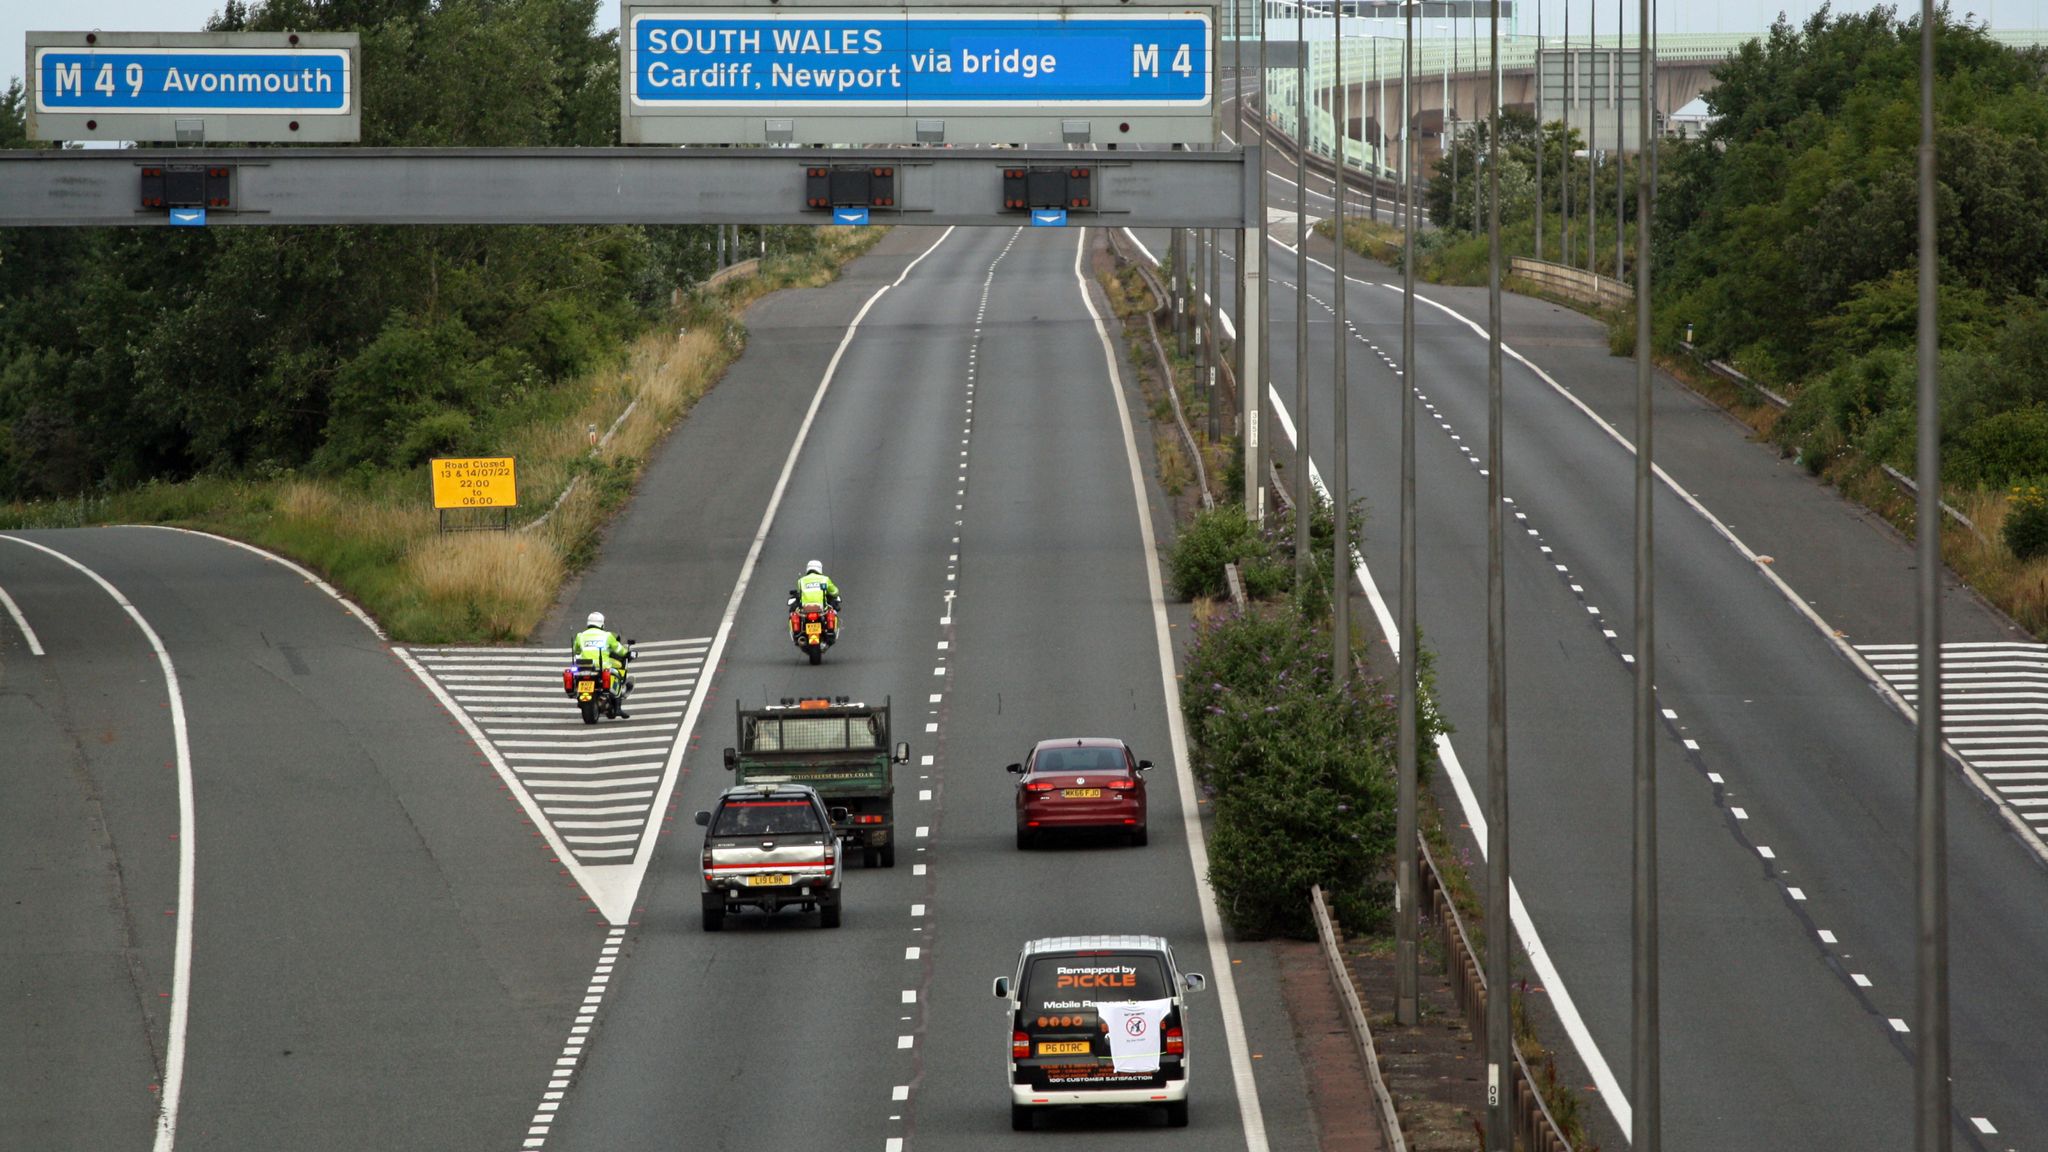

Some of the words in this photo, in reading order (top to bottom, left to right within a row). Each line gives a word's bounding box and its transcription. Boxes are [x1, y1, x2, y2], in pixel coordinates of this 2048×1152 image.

[648, 28, 760, 54] SOUTH
[772, 28, 883, 54] WALES
[910, 47, 952, 73] via
[962, 48, 1057, 78] bridge
[162, 67, 332, 93] Avonmouth
[647, 61, 761, 90] Cardiff,
[771, 63, 901, 92] Newport
[444, 461, 469, 469] Road
[472, 460, 506, 469] Closed
[441, 470, 451, 478] 13
[466, 468, 510, 477] 14/07/22
[460, 480, 490, 488] 22:00
[462, 497, 493, 505] 06:00
[1057, 966, 1120, 975] Remapped
[1122, 966, 1136, 976] by
[1057, 974, 1136, 988] PICKLE
[1043, 1001, 1081, 1009] Mobile
[1045, 1044, 1058, 1052] P6
